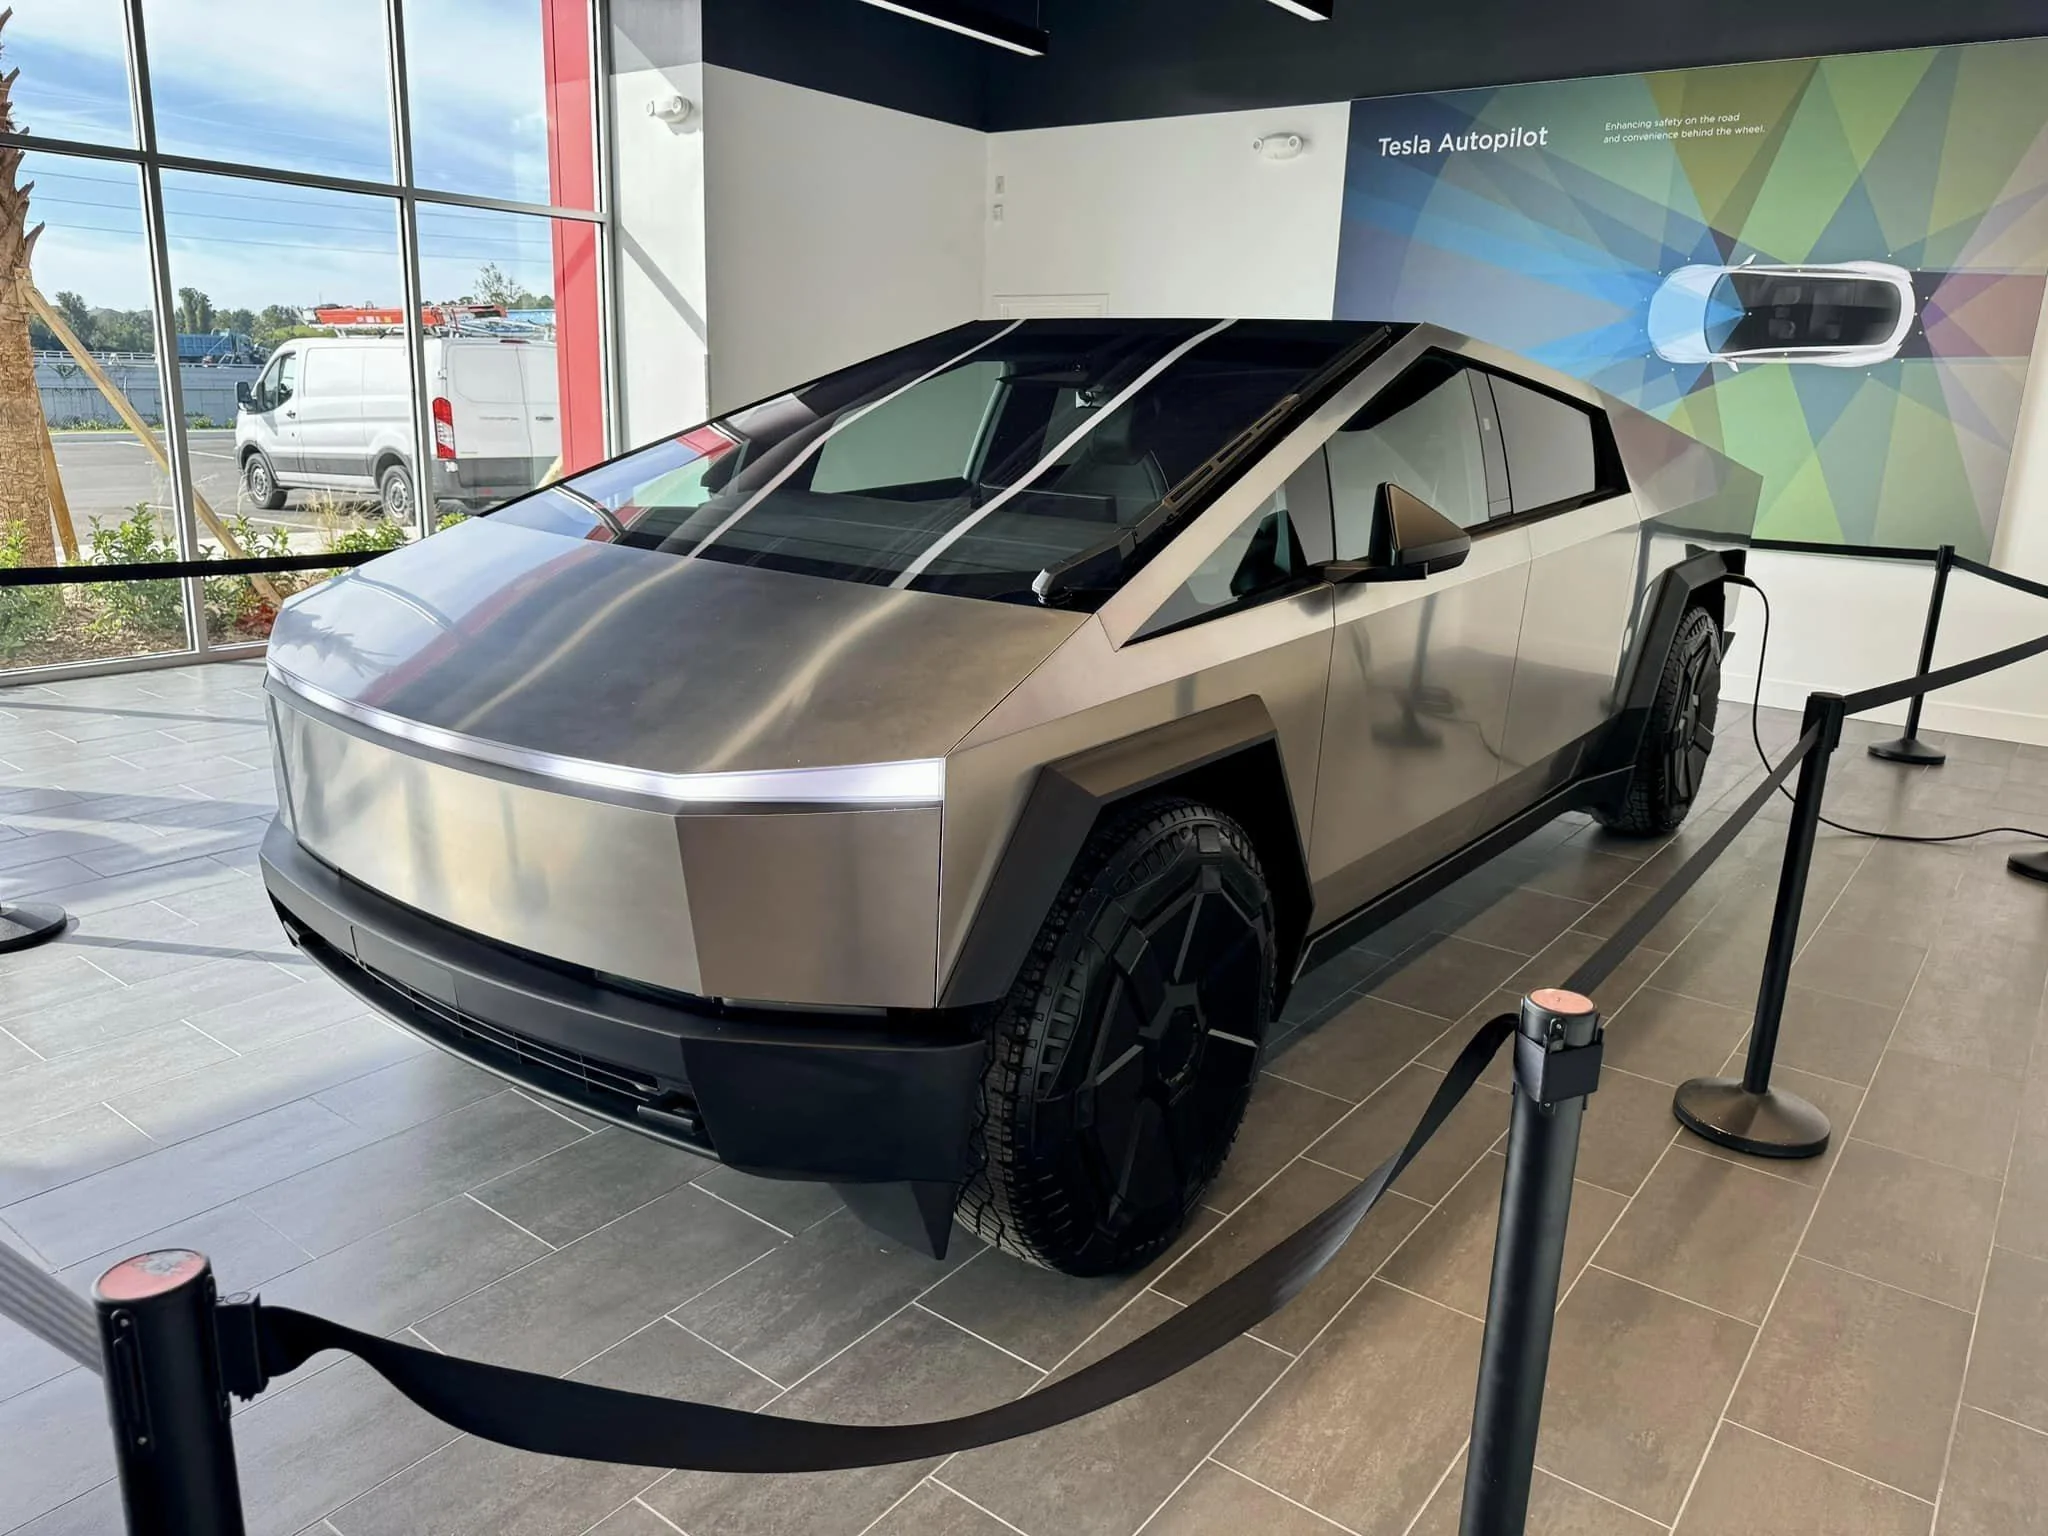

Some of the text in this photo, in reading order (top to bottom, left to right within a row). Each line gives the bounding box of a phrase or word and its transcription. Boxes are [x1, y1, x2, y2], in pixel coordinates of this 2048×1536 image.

[1605, 113, 1740, 131] Enhancing safety on the road
[1378, 126, 1549, 157] Tesla Autopilot
[1604, 124, 1765, 143] and convenience behind the wheel.
